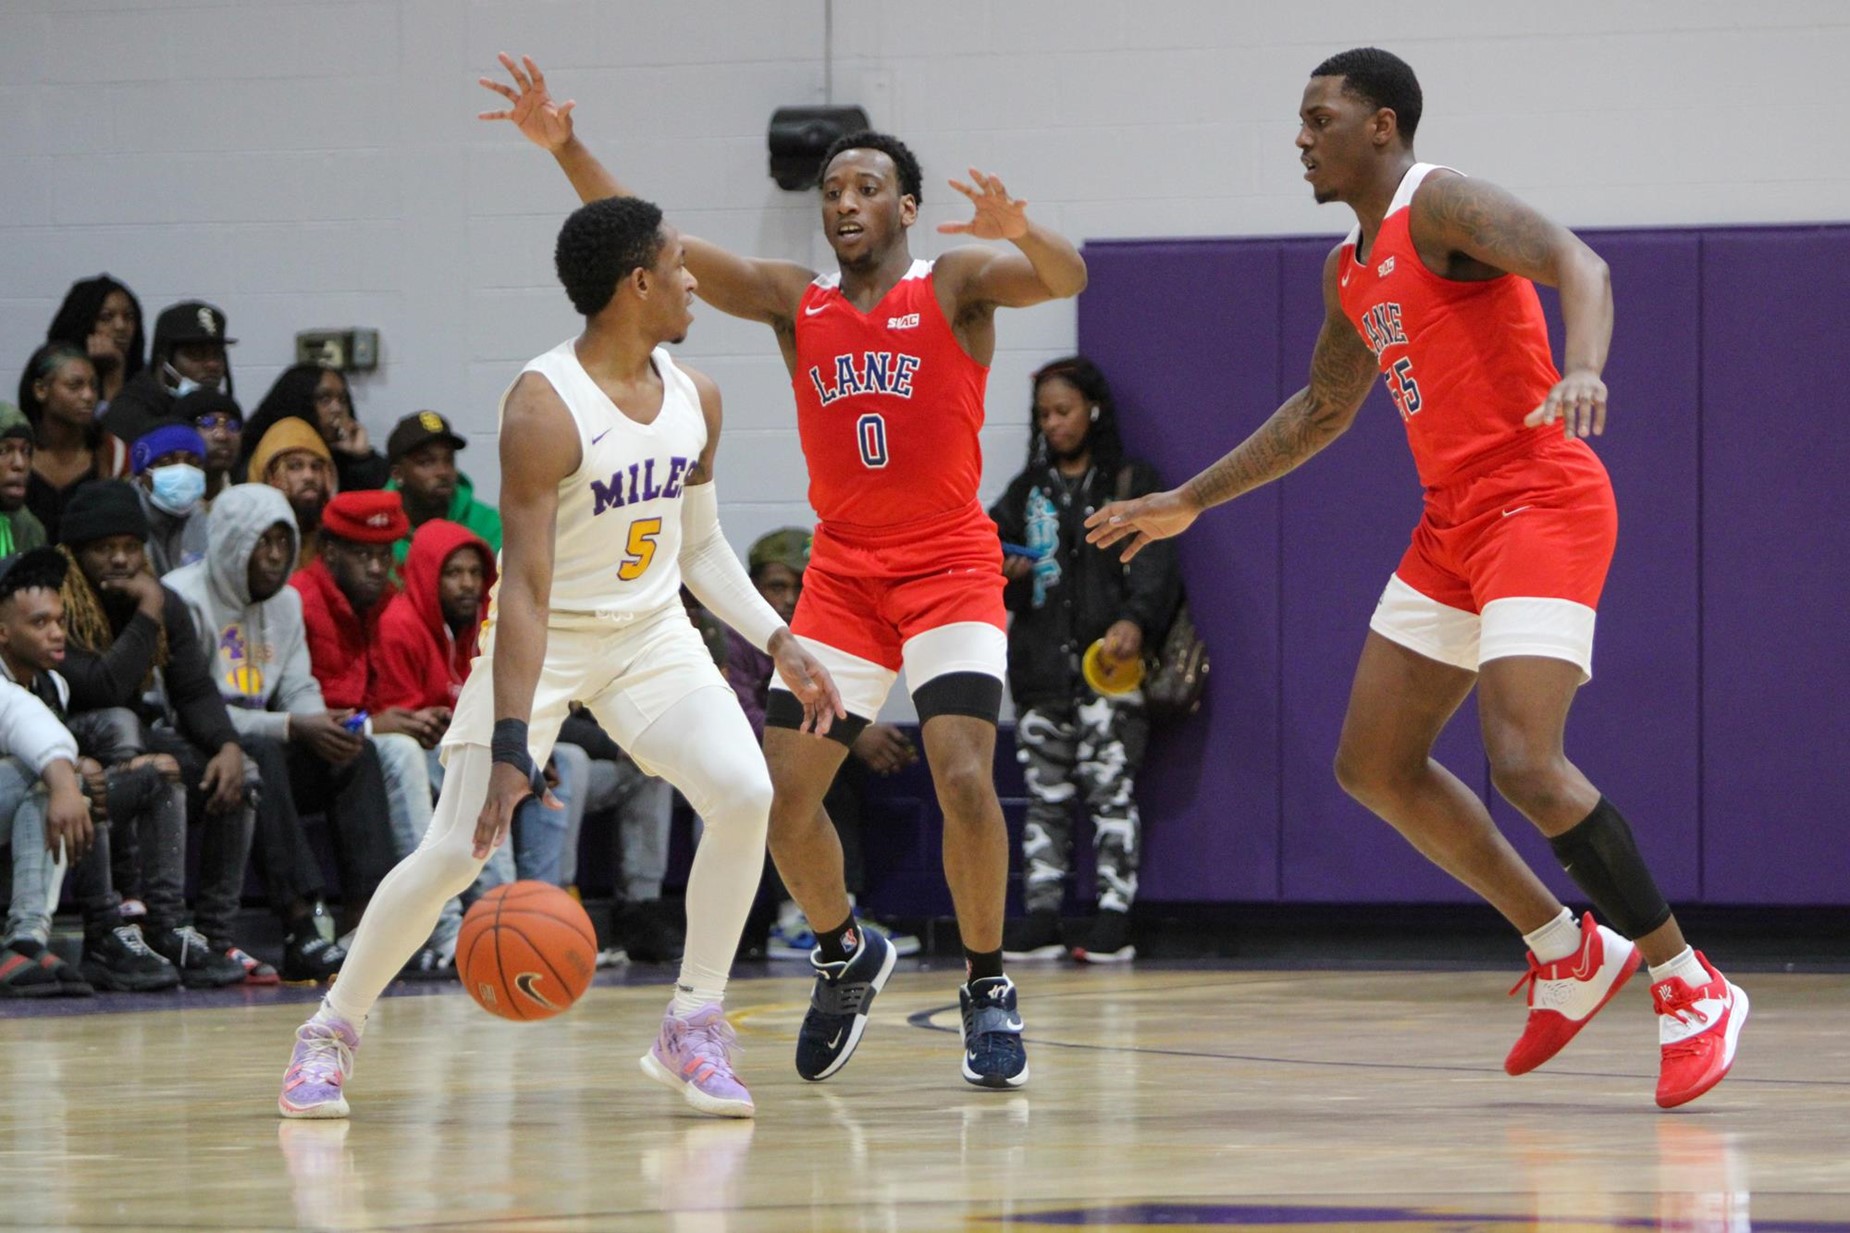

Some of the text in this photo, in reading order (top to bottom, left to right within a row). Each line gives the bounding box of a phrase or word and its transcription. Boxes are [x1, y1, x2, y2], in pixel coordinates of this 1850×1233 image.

[1361, 301, 1409, 358] ANE
[809, 351, 921, 407] LANE
[1384, 355, 1422, 422] 5
[856, 413, 889, 469] 0
[617, 516, 662, 581] 5
